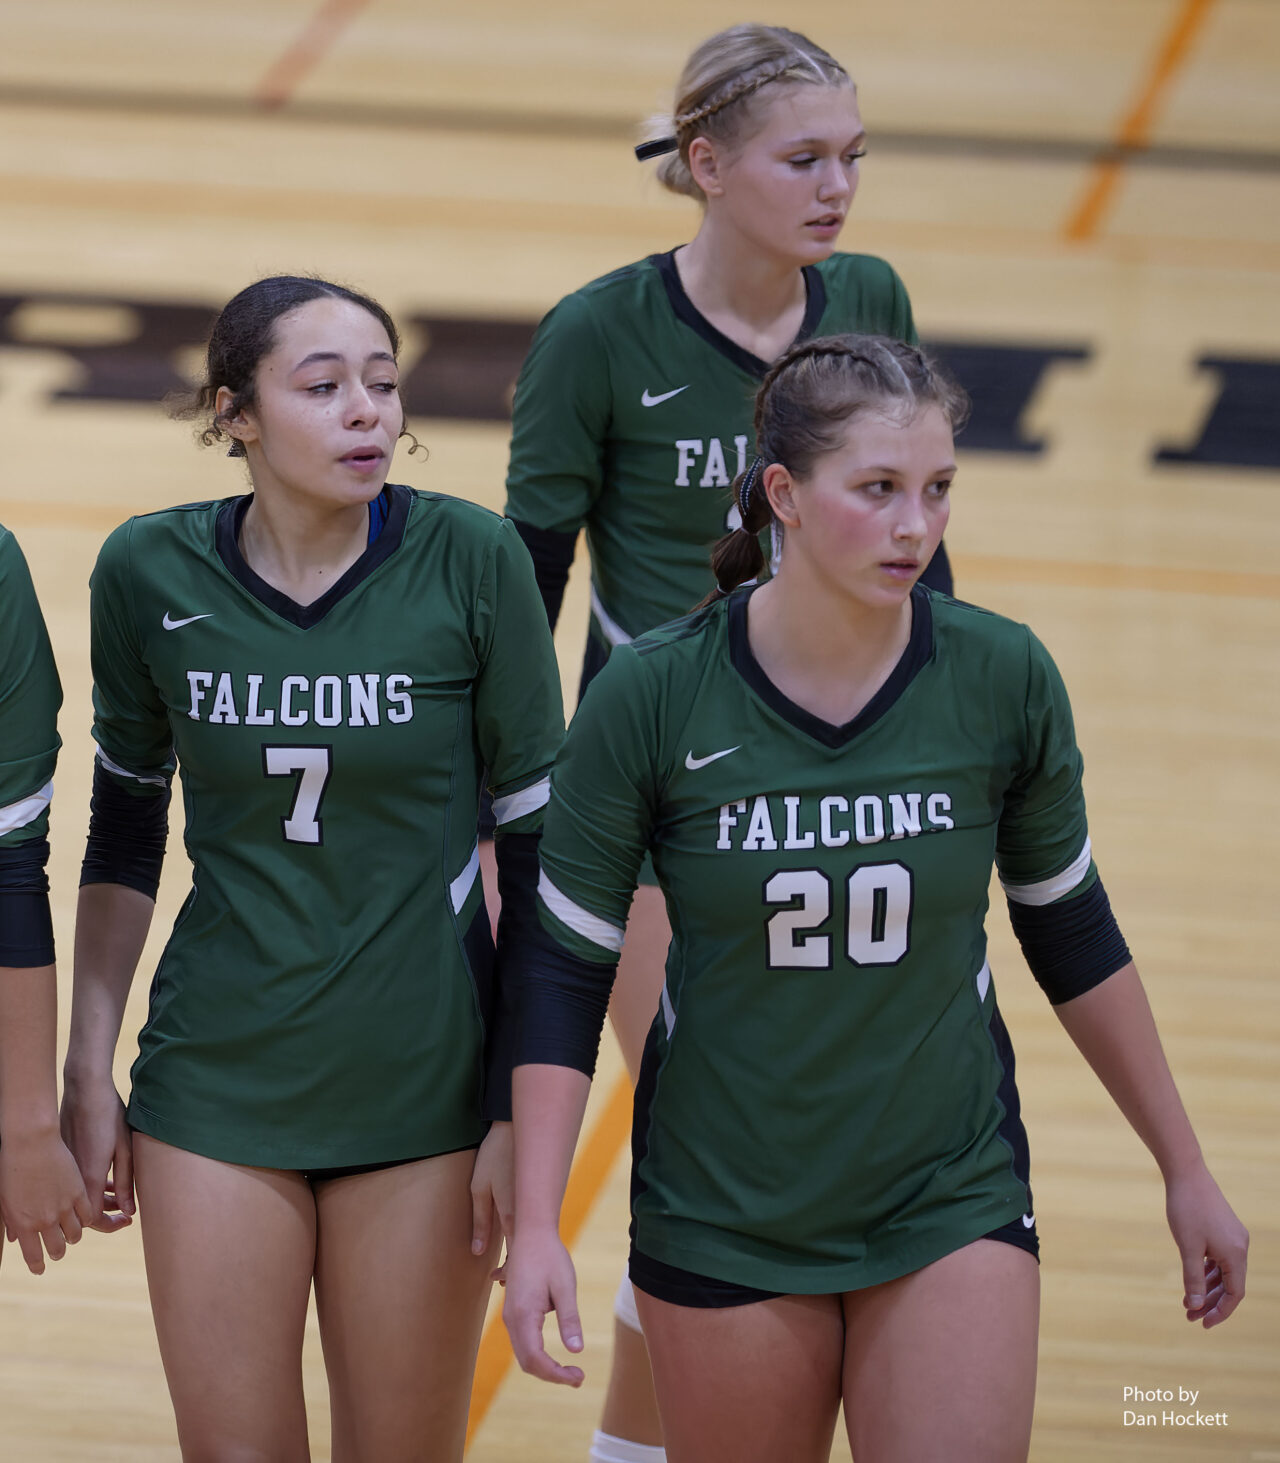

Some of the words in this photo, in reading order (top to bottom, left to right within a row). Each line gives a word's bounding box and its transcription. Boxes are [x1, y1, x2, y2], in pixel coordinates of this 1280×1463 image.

[186, 670, 414, 727] FALCONS
[262, 743, 333, 846] 7
[716, 793, 955, 851] FALCONS
[762, 859, 915, 971] 20
